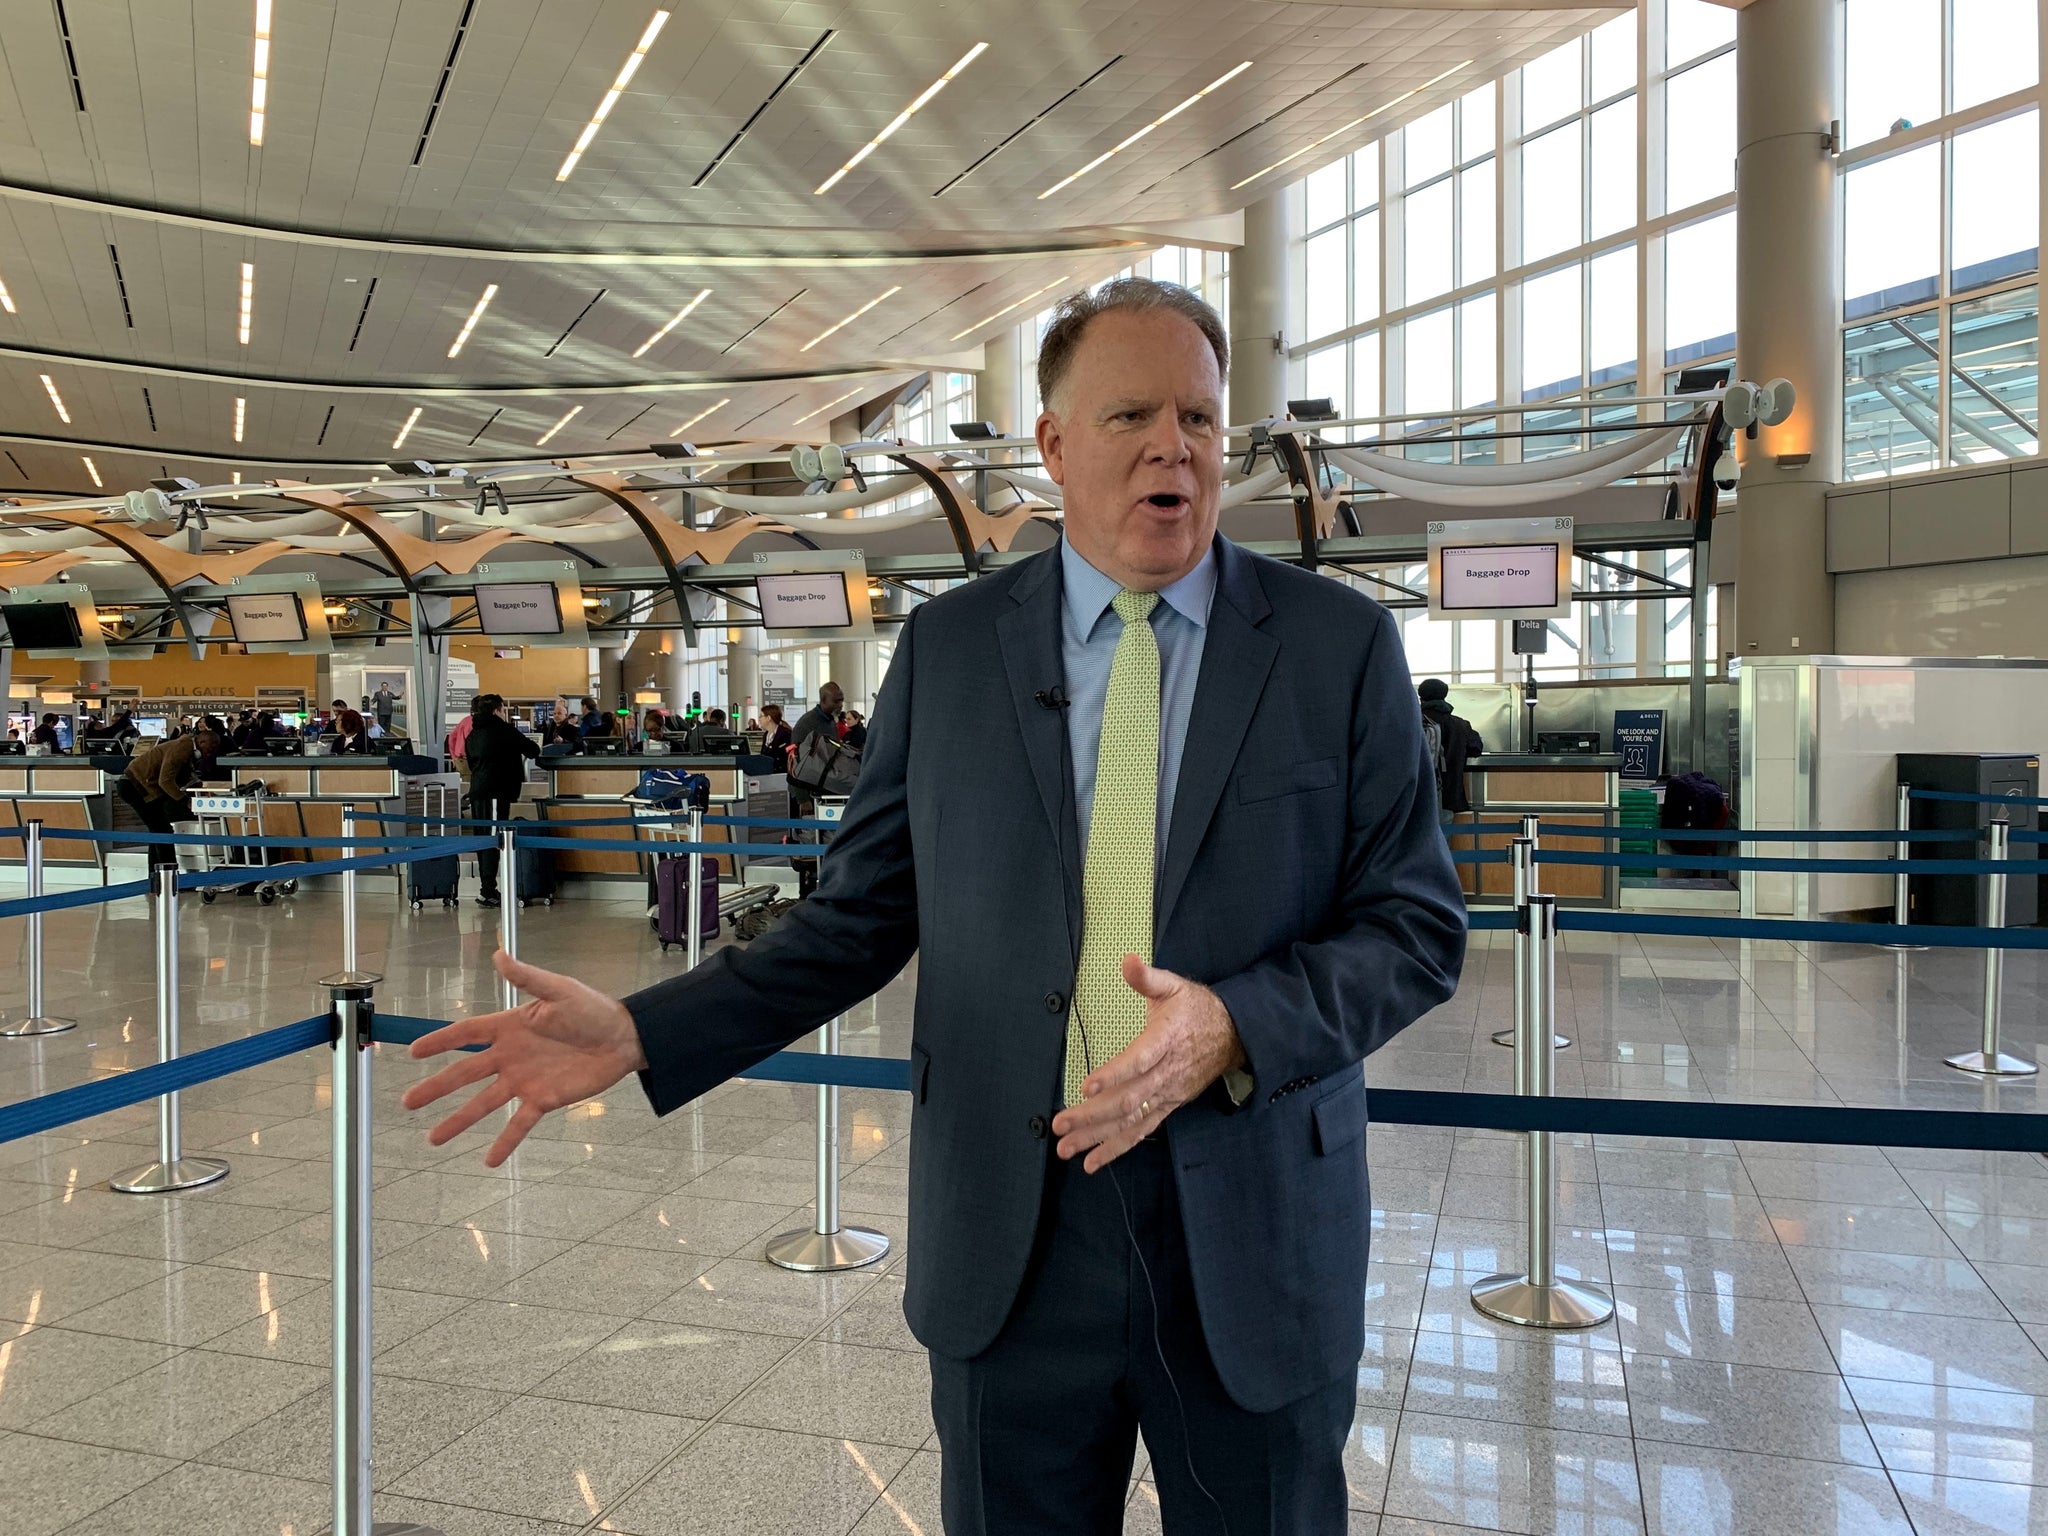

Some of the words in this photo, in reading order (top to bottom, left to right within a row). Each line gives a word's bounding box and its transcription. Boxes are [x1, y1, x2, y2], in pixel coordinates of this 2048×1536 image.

[1555, 518, 1572, 529] 30
[1428, 523, 1445, 534] 29
[755, 554, 767, 563] 25
[850, 550, 863, 560] 26
[479, 564, 489, 573] 23
[563, 561, 575, 570] 24
[306, 573, 316, 582] 22
[1466, 569, 1505, 578] Baggage
[1507, 568, 1530, 577] Drop
[231, 577, 240, 585] 21
[9, 586, 18, 594] 19
[79, 584, 88, 592] 20
[777, 594, 807, 602] Baggage
[808, 592, 826, 601] Drop
[493, 602, 521, 610] Baggage
[521, 601, 538, 609] Drop
[244, 612, 268, 620] Baggage
[1520, 620, 1540, 629] Delta
[164, 687, 188, 697] ALL
[192, 687, 236, 697] GATES
